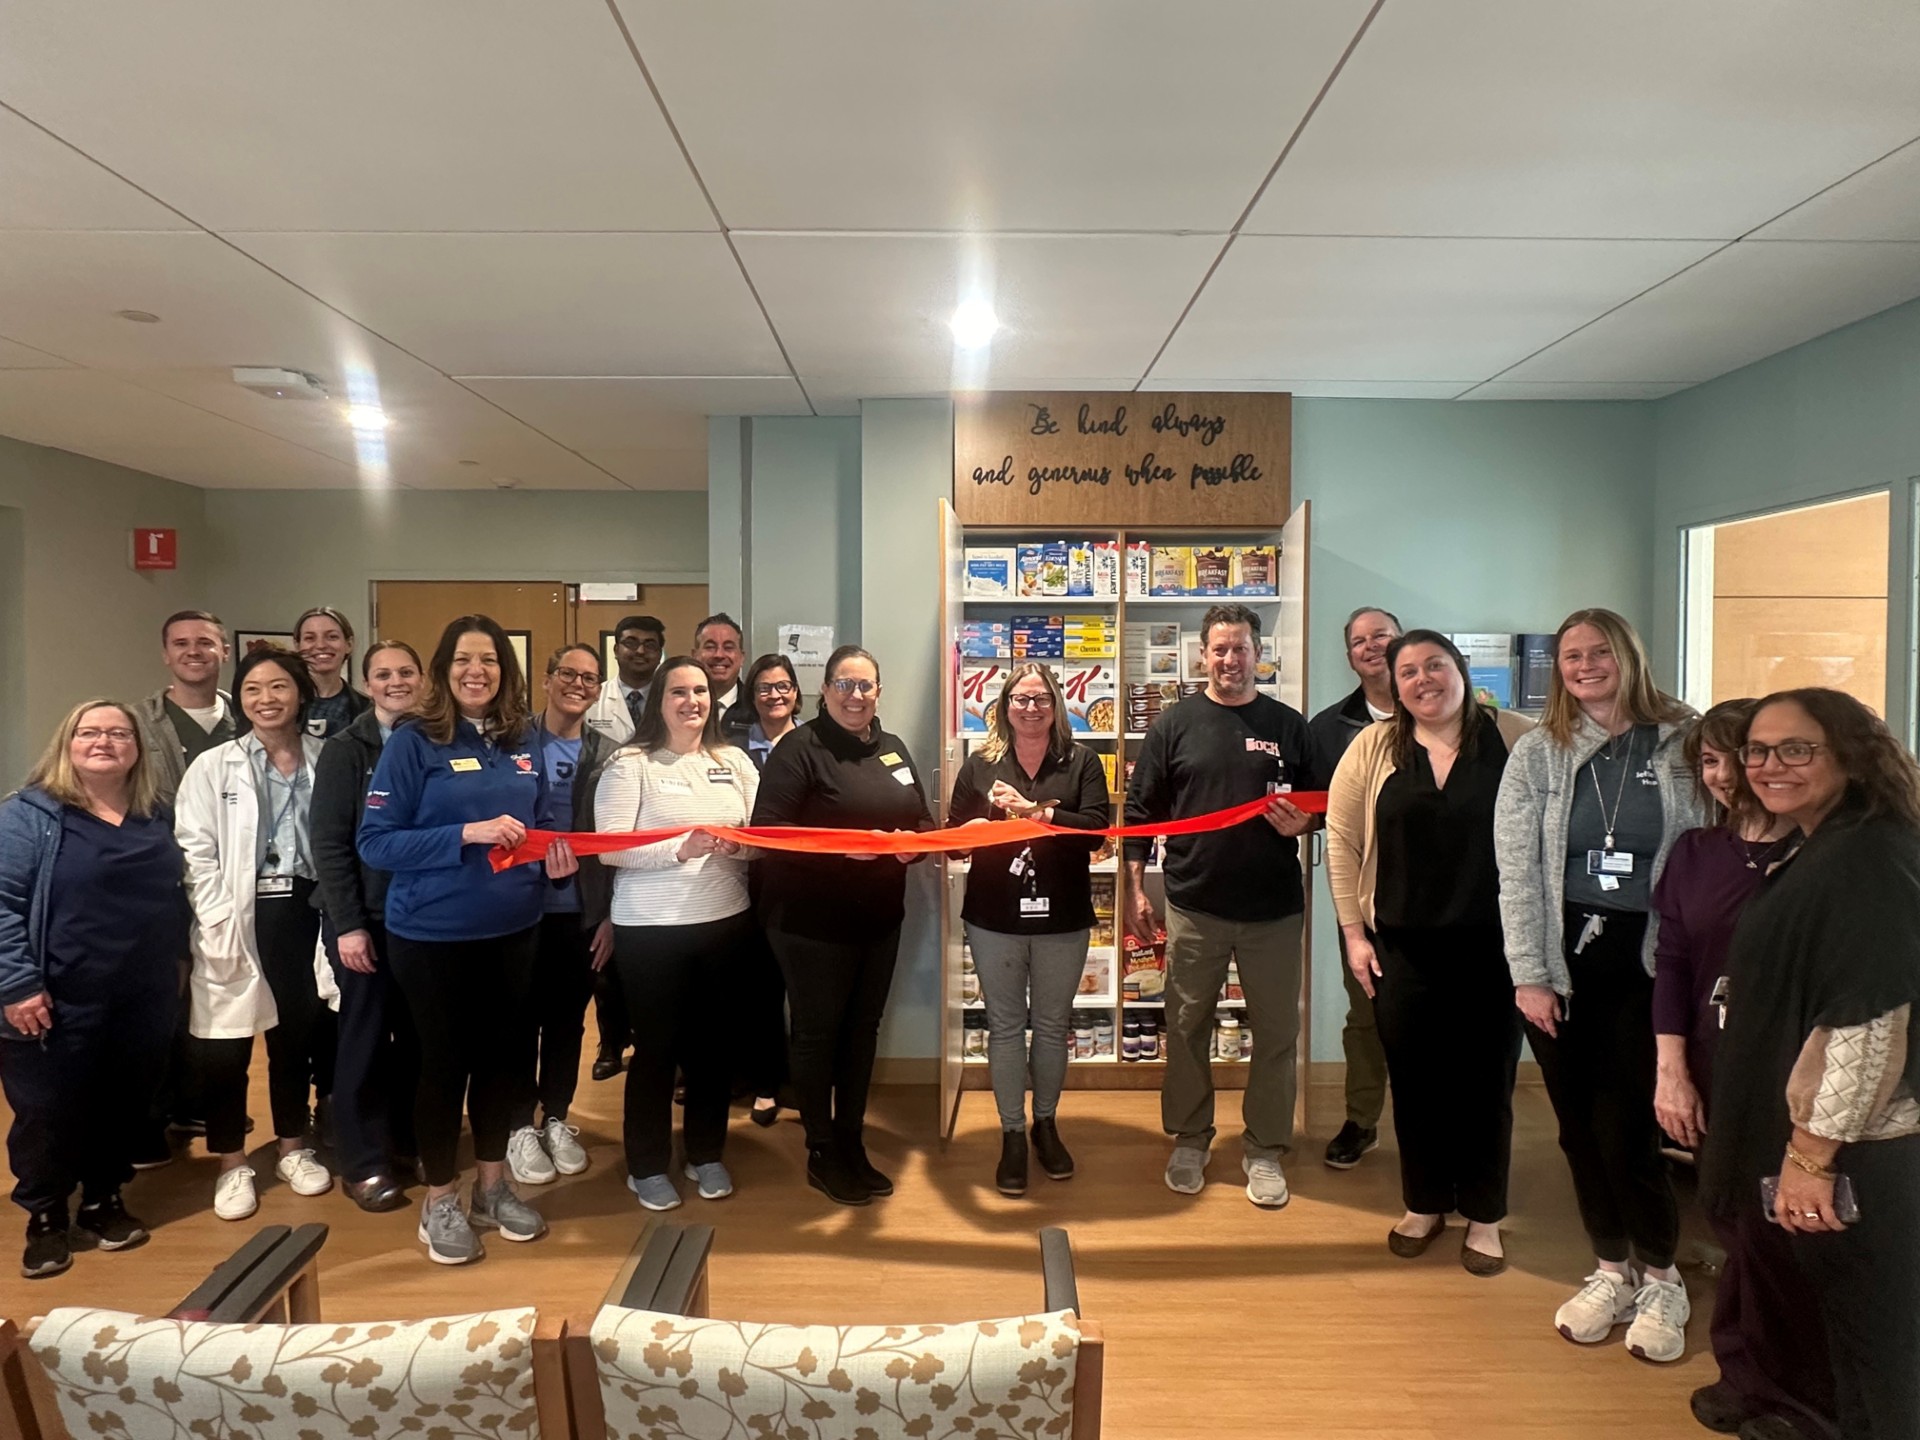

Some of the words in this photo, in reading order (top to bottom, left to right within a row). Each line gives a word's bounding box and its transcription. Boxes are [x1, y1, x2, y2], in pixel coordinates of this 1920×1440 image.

[1029, 403, 1060, 435] Be
[1078, 403, 1128, 437] kind
[1151, 403, 1226, 446] always
[972, 455, 1014, 486] and
[1028, 464, 1112, 495] generous
[1125, 453, 1177, 486] when
[1190, 453, 1263, 490] possible
[1109, 556, 1117, 595] parmalat
[1140, 556, 1148, 595] parmalat
[1198, 569, 1228, 577] BREAKFAST
[963, 664, 999, 703] K
[1066, 664, 1102, 703] K
